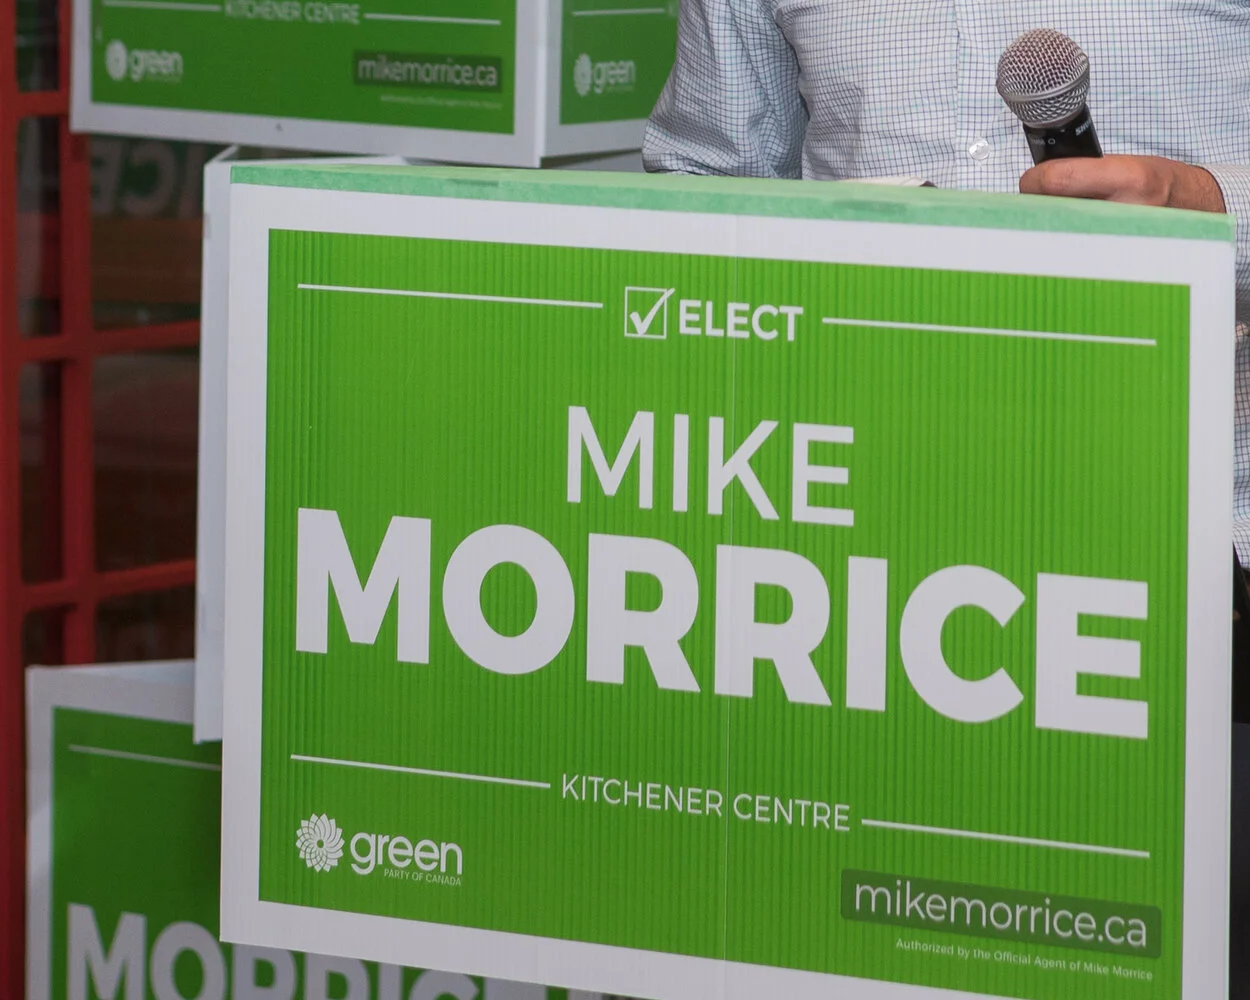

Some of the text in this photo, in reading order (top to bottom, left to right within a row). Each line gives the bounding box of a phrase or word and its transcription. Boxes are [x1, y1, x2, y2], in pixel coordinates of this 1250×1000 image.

[303, 1, 360, 25] CENTRE
[130, 48, 184, 82] green
[358, 56, 498, 87] mikemorrice.ca
[593, 60, 636, 94] green
[678, 299, 805, 342] ELECT
[566, 404, 855, 528] MIKE
[295, 507, 1149, 740] MORRICE
[562, 773, 850, 832] KITCHENER CENTRE
[350, 832, 463, 876] green
[384, 868, 462, 886] PARTY OF CANADA
[855, 880, 1147, 949] mikemorrice.ca
[896, 938, 1153, 981] Authorized by the Official Agent of Mike Morrice
